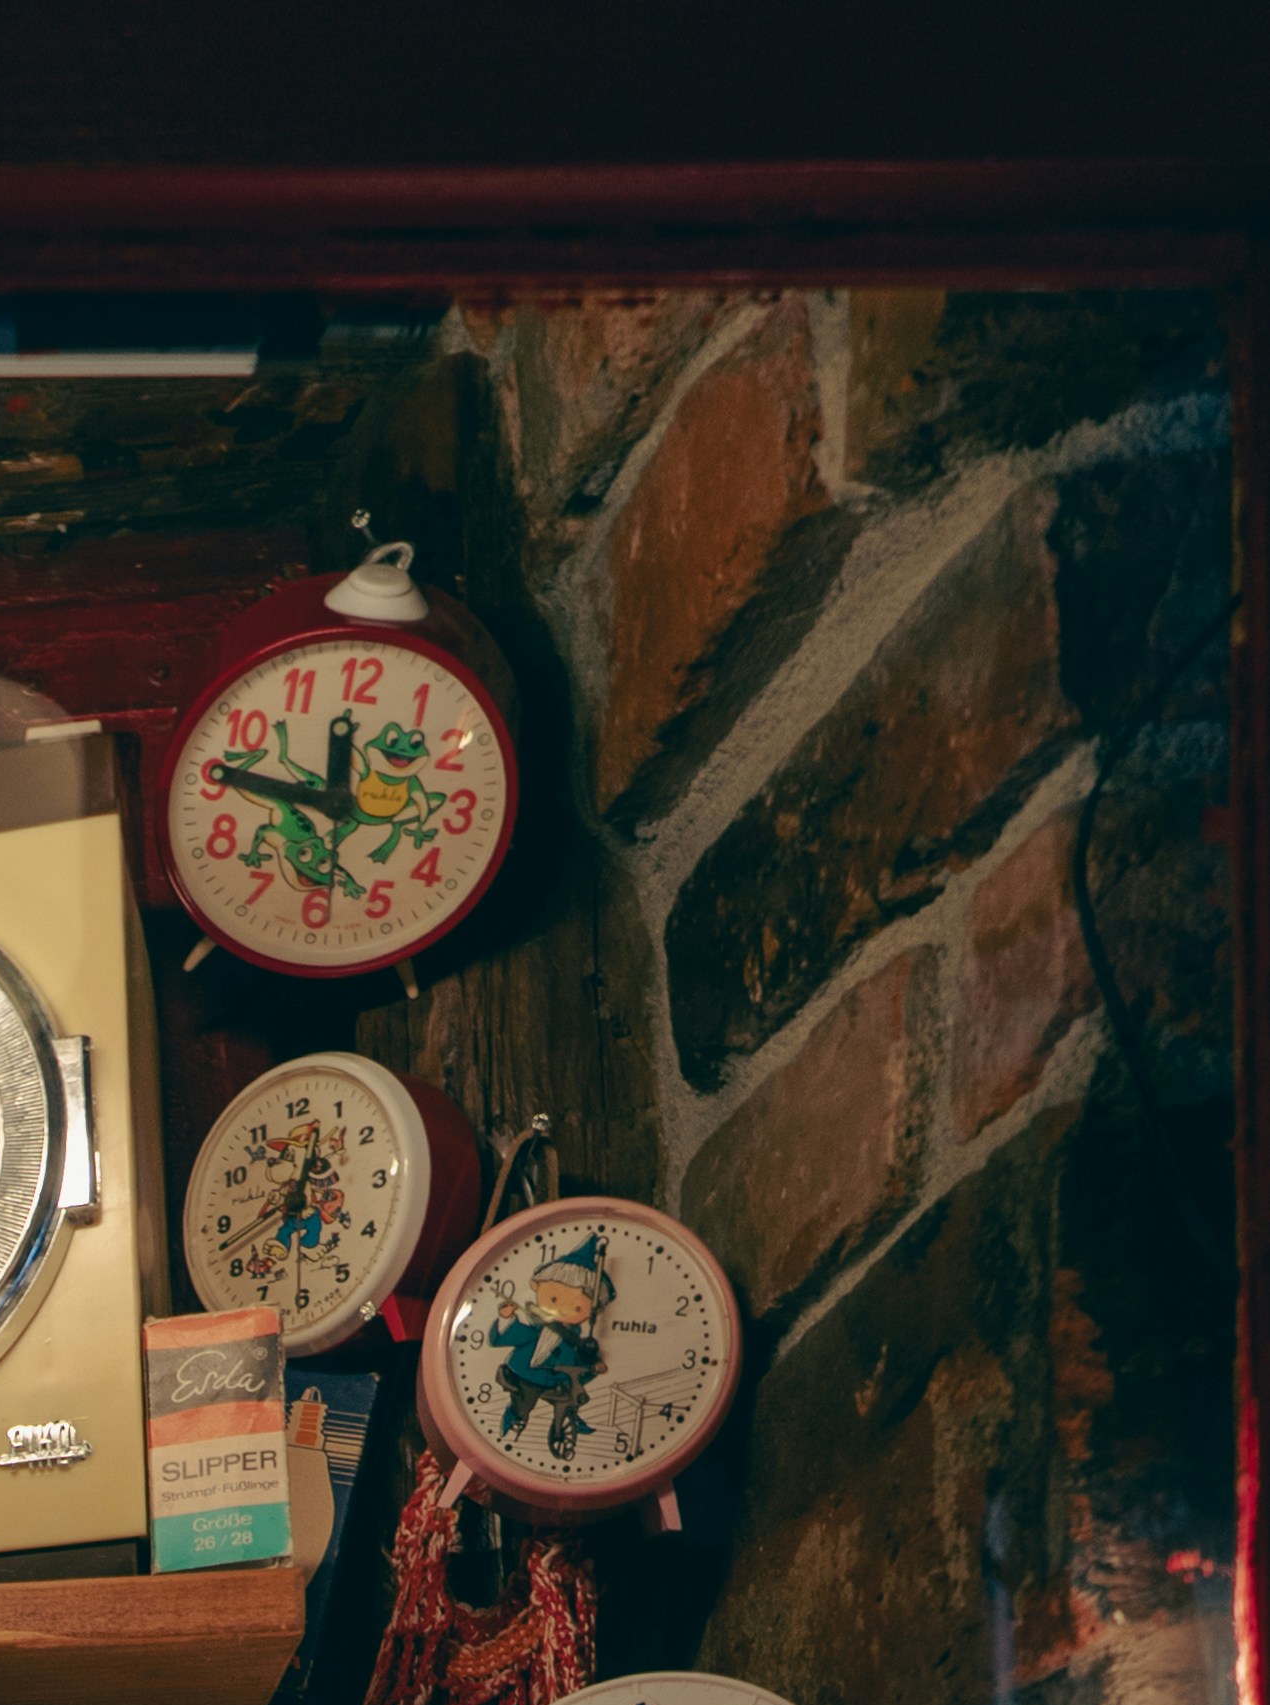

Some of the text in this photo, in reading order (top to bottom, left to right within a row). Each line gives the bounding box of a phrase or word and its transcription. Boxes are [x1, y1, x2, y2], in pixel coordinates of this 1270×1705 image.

[282, 667, 317, 715] 11
[340, 657, 384, 706] 12
[411, 683, 431, 728] 1
[225, 709, 269, 751] 10
[434, 728, 468, 772] 2
[199, 757, 229, 801] 9
[442, 788, 478, 835] 3
[205, 813, 237, 860] 8
[243, 870, 275, 906] 7
[410, 847, 443, 888] 4
[300, 888, 331, 929] 6
[364, 880, 396, 919] 5
[611, 1318, 658, 1336] ruhla
[161, 1449, 279, 1484] SLIPPER
[192, 1512, 254, 1534] Größe
[194, 1532, 254, 1553] 26 28
